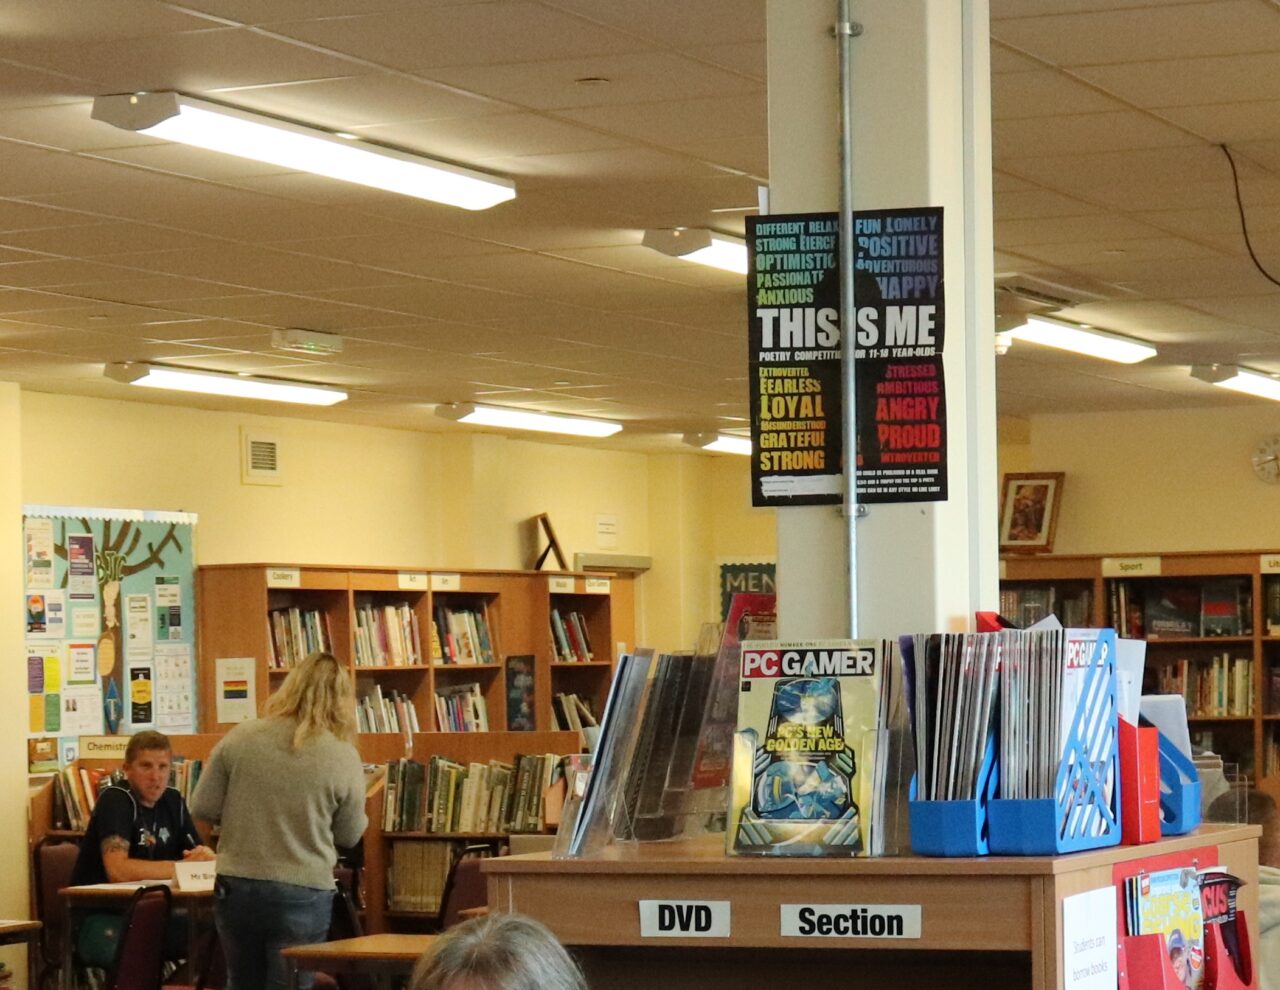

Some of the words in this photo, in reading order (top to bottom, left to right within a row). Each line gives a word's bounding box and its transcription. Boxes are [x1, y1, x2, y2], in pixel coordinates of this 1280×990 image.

[756, 222, 805, 236] DIFFERENT
[809, 220, 840, 234] RELAX
[855, 218, 881, 234] FUN
[886, 216, 938, 233] LONELY
[756, 237, 797, 252] STRONG
[756, 288, 814, 306] ANXIOUS
[756, 308, 841, 348] THIS
[885, 305, 936, 346] ME
[759, 351, 791, 362] POETRY
[854, 348, 866, 359] OR
[892, 347, 936, 358] YEAR-OLDS
[760, 379, 821, 394] FEARLESS
[760, 395, 825, 420] LOYAL
[876, 397, 939, 421] ANGRY
[877, 424, 941, 450] PROUD
[760, 451, 825, 471] STRONG
[1119, 561, 1143, 571] Sport
[744, 651, 778, 676] PC
[781, 650, 874, 675] GAMER
[777, 723, 804, 738] PC'S
[807, 724, 834, 738] NEW
[87, 741, 127, 752] Chemistr
[767, 738, 815, 751] GOLDEN
[818, 737, 845, 751] AGE
[658, 904, 712, 932] DVD
[798, 907, 904, 936] Section
[1073, 938, 1096, 955] Students
[1090, 960, 1108, 977] books
